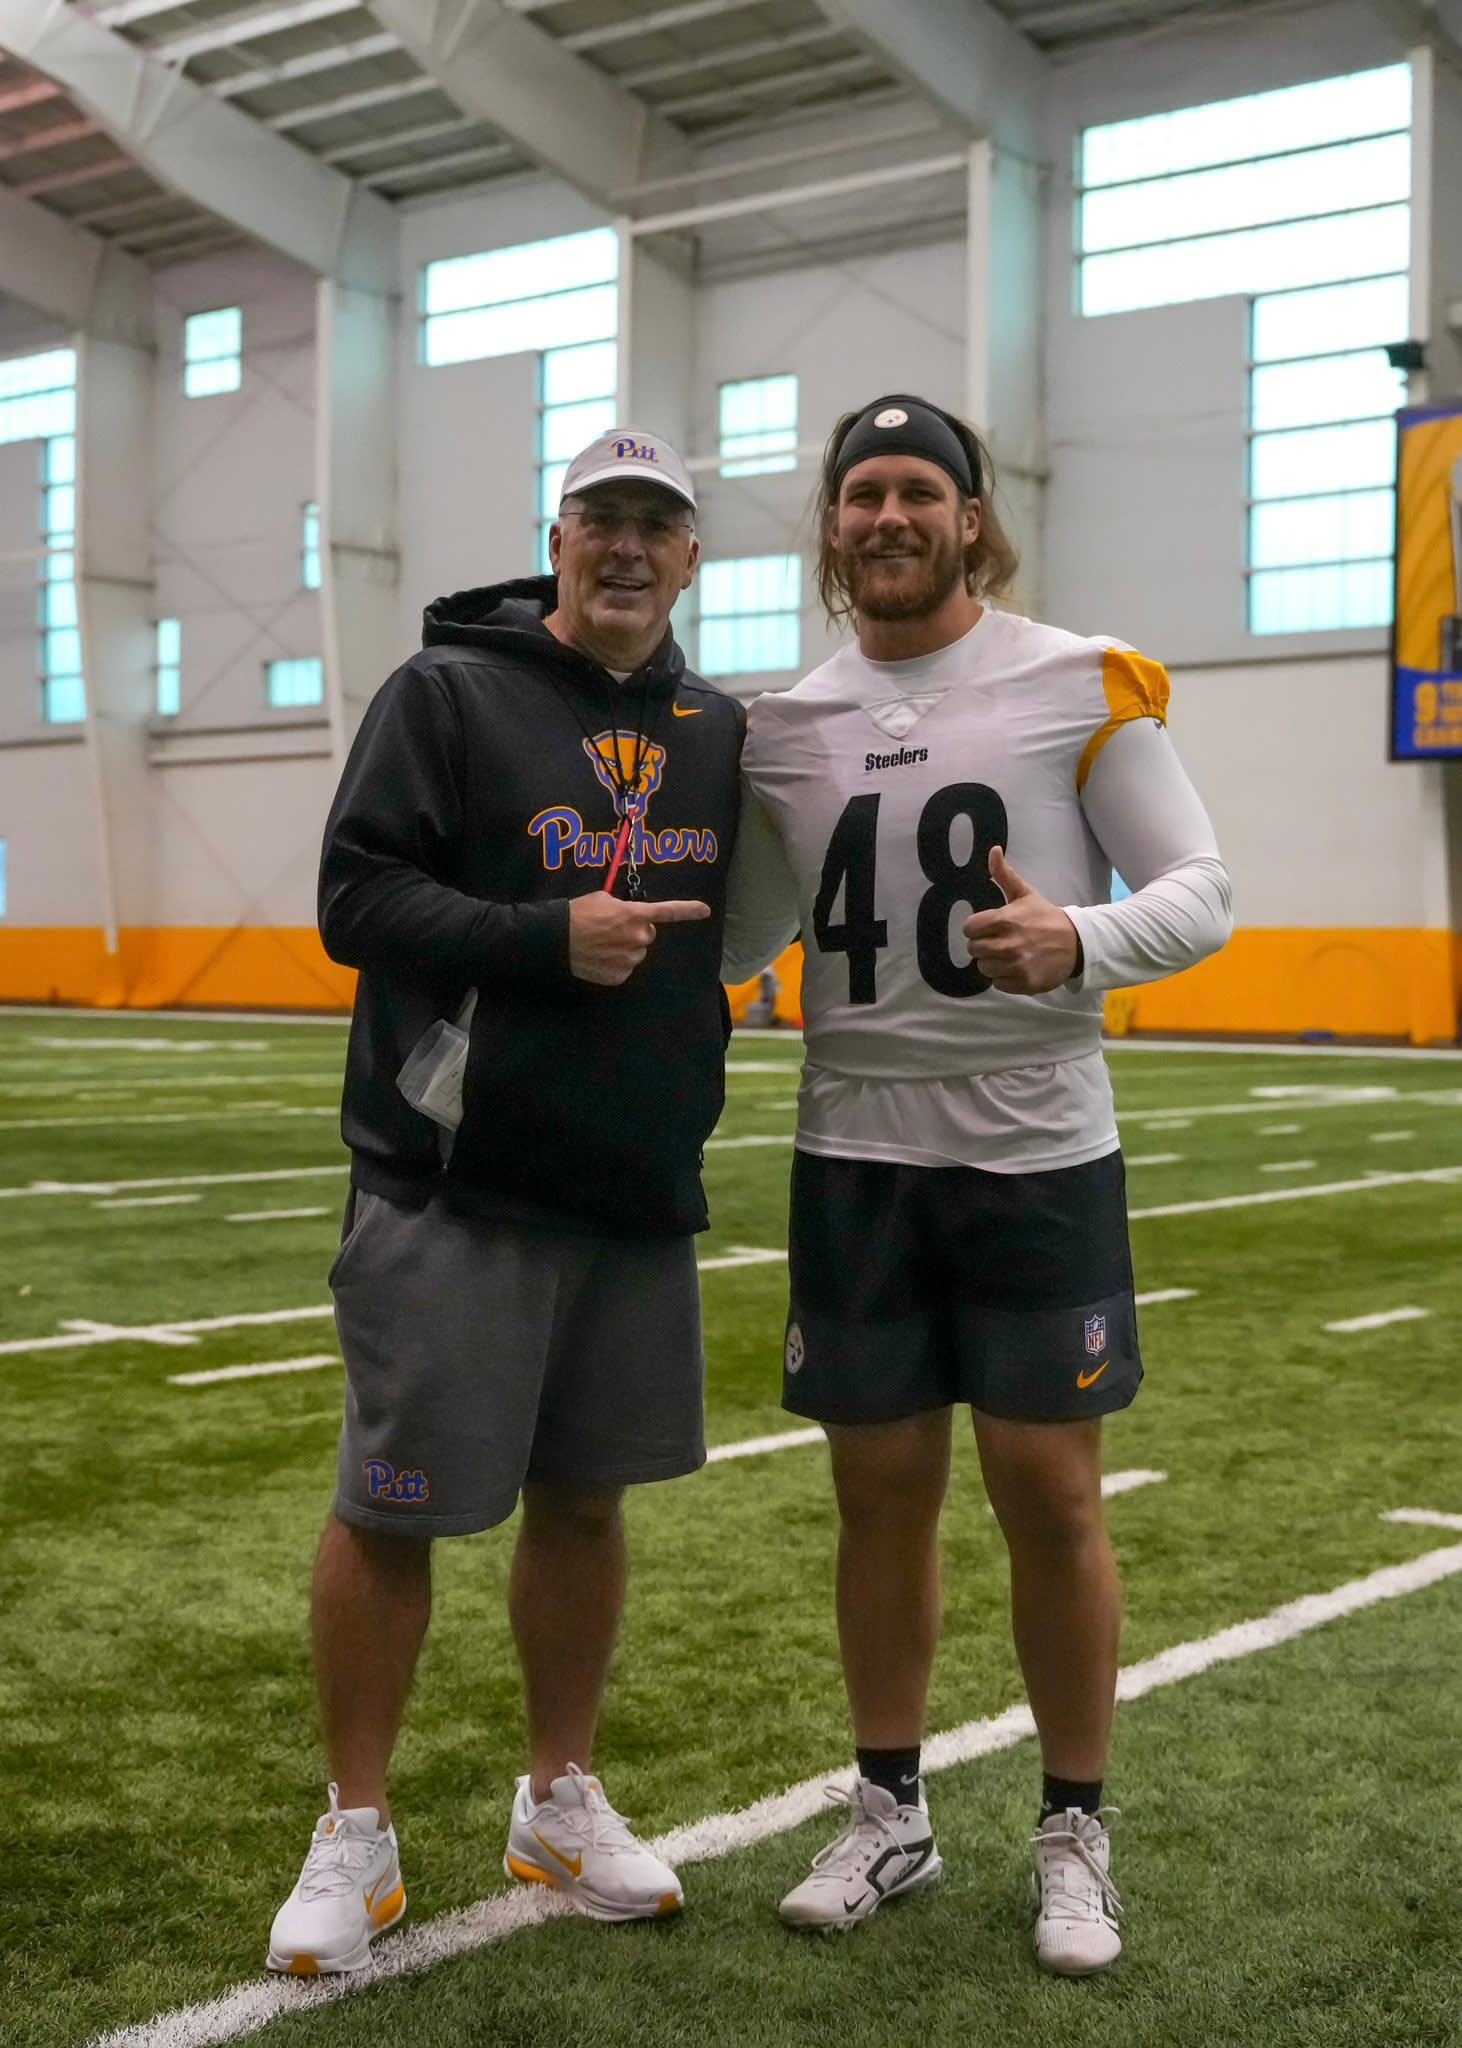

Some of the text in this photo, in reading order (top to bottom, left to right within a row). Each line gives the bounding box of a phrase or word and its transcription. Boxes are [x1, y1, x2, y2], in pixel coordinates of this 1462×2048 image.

[610, 438, 659, 463] Pitt
[865, 747, 928, 771] Steelers
[812, 782, 1008, 1004] 48
[1088, 1331, 1104, 1349] NFL
[363, 1459, 429, 1502] Pitt
